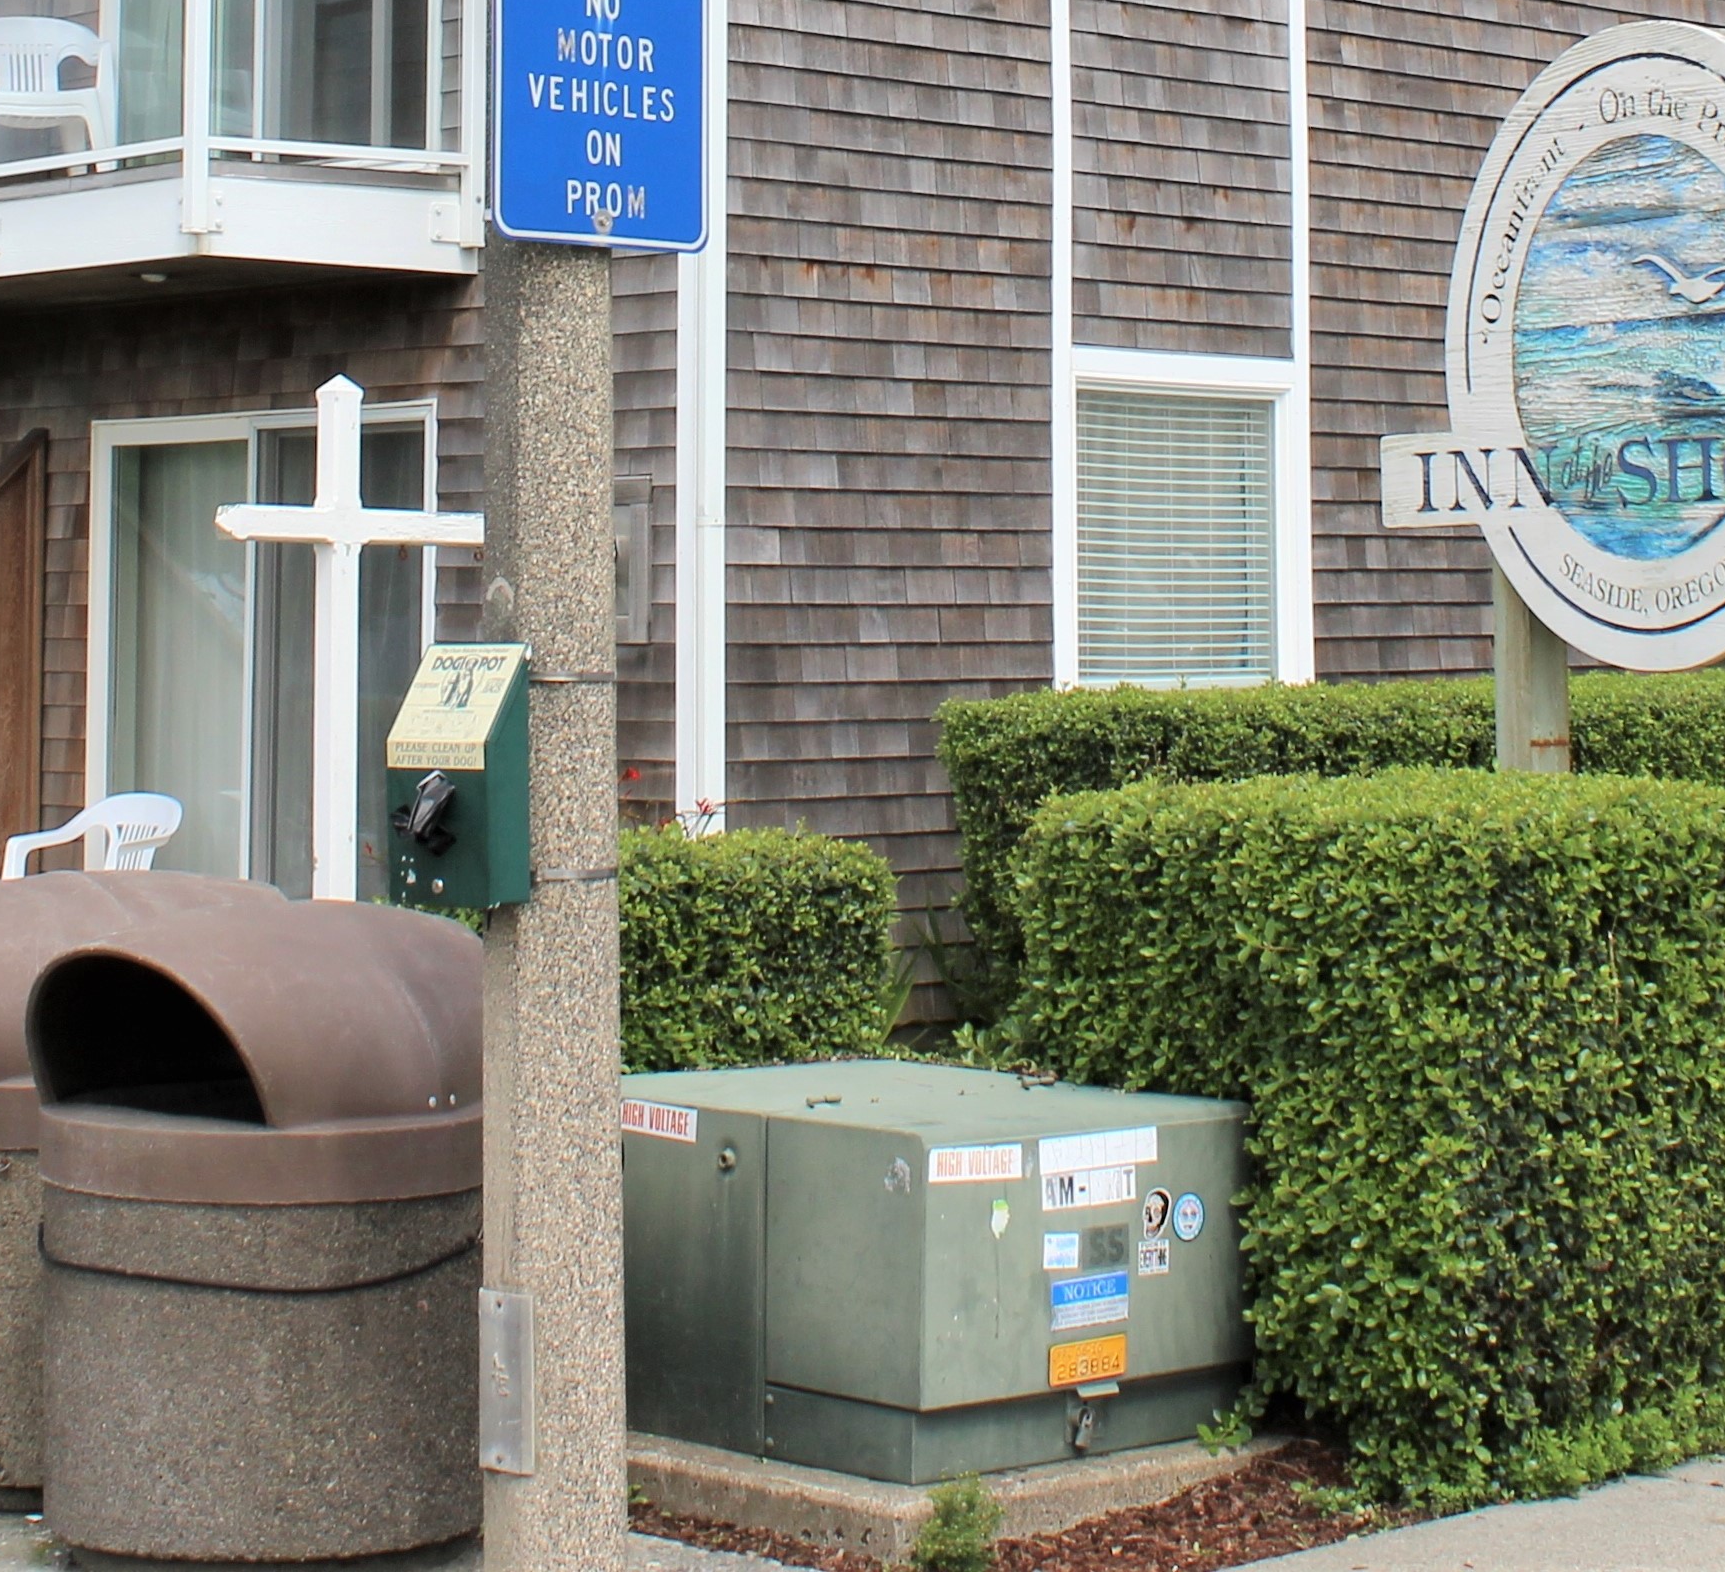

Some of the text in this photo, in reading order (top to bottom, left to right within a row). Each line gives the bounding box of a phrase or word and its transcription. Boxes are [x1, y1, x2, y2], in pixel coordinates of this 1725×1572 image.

[556, 26, 655, 74] MOTOR
[527, 72, 676, 122] VEHICLES
[1598, 88, 1637, 125] On
[1646, 87, 1688, 119] the
[585, 129, 622, 167] ON
[565, 178, 646, 220] PROM
[1413, 444, 1559, 513] INN
[1558, 552, 1649, 617] SEASIDE,
[394, 755, 423, 766] AFTER
[426, 755, 452, 767] YOUR
[395, 741, 477, 754] PLEASE CLEAN UP
[622, 1102, 690, 1137] HIGH VOLTAGE
[936, 1151, 963, 1177] HIGH
[967, 1148, 1014, 1176] VOLTAGE
[1063, 1278, 1117, 1302] NOTICE
